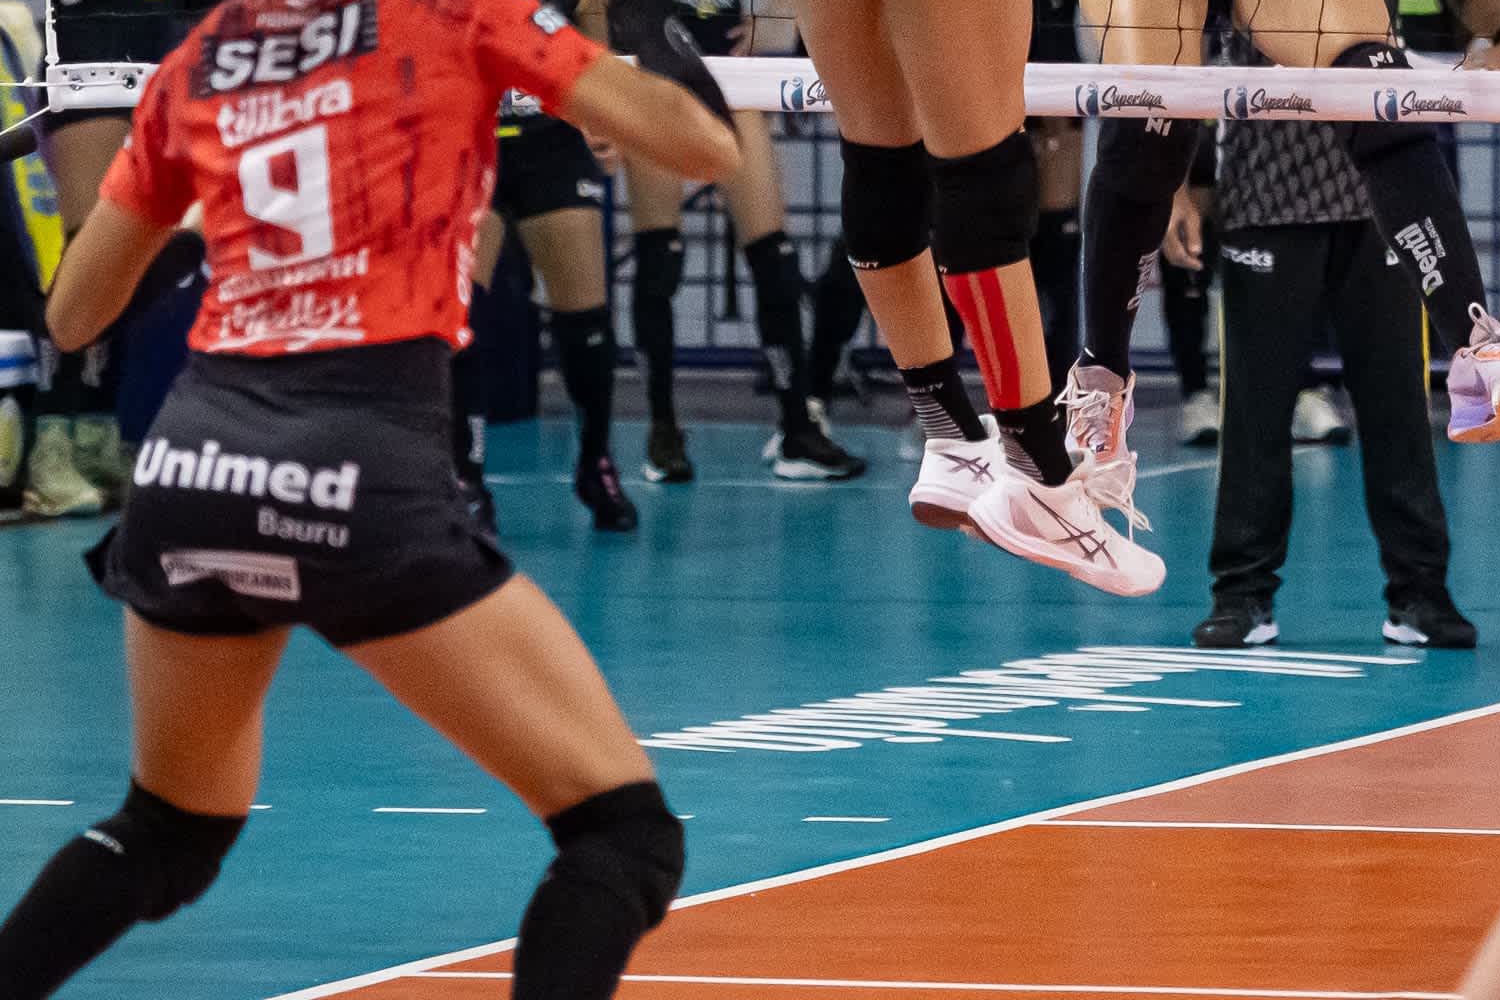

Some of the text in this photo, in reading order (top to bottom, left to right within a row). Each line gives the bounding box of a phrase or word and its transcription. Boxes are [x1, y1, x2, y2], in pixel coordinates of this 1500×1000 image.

[210, 2, 361, 91] SESI
[217, 79, 353, 149] tilibra
[1101, 86, 1167, 111] Superliga
[1250, 88, 1317, 113] Superliga
[1400, 90, 1467, 115] Superliga
[238, 124, 334, 271] 9
[132, 436, 360, 511] Unimed
[257, 507, 350, 549] Bauru
